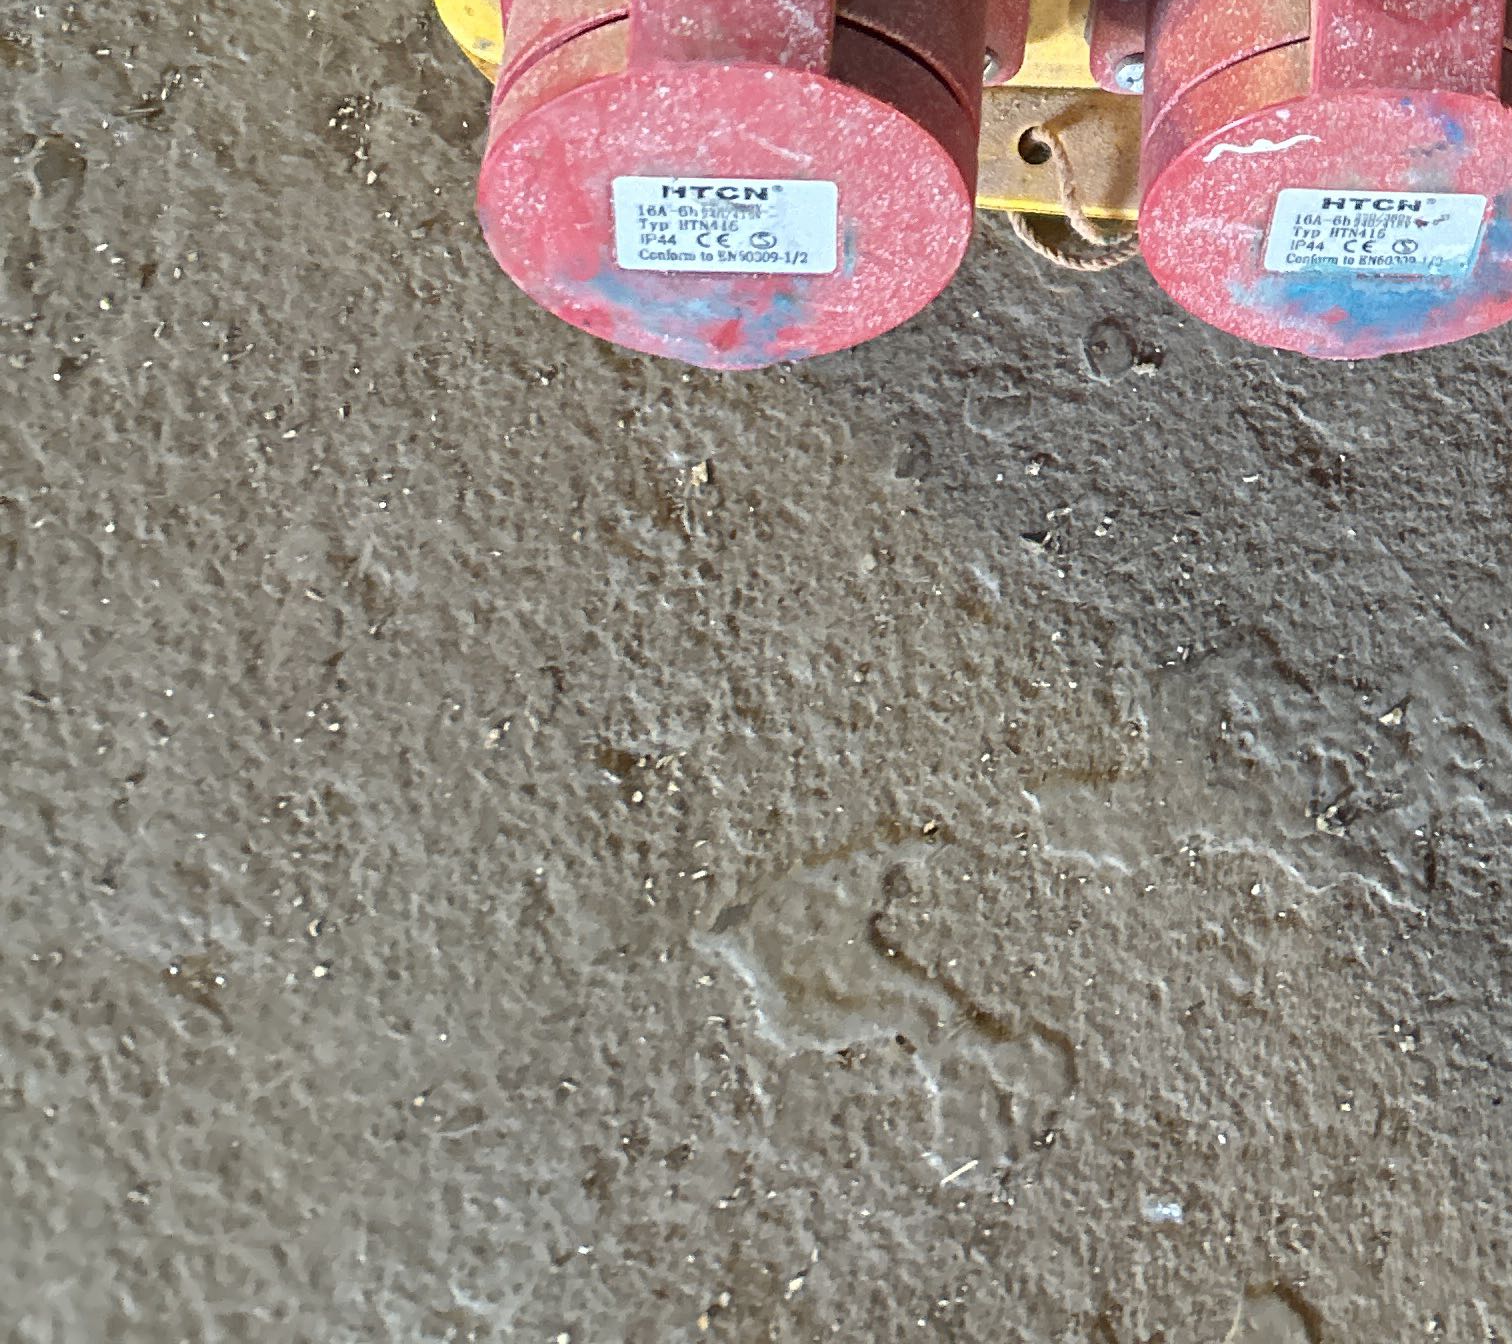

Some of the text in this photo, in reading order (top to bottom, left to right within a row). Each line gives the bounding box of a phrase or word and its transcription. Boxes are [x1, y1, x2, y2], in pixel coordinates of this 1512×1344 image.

[662, 185, 770, 201] HTCN
[1321, 197, 1423, 213] HTCN
[638, 218, 740, 233] Typ HTN416
[641, 233, 677, 245] IP44
[1293, 226, 1387, 240] Typ HTN416
[1290, 239, 1325, 252] IP44
[638, 248, 696, 261] Conform
[700, 251, 714, 262] to
[1342, 255, 1356, 265] to
